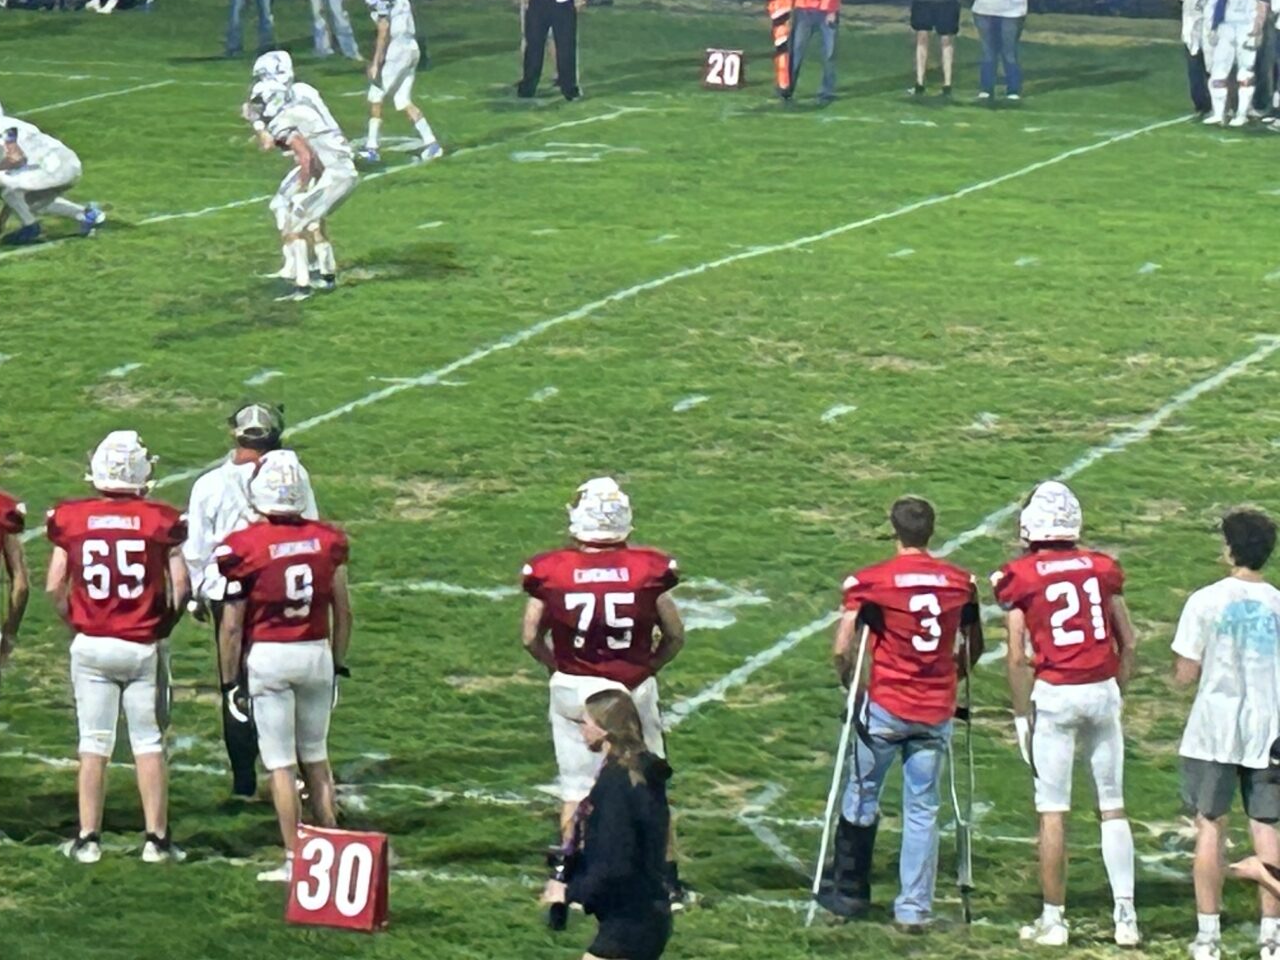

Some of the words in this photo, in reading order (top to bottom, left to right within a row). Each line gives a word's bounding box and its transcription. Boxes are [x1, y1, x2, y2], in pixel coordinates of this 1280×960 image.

[706, 53, 741, 86] 20
[82, 539, 146, 599] 65
[283, 563, 314, 619] 9
[563, 591, 634, 650] 75
[908, 592, 942, 652] 3
[1044, 577, 1106, 647] 21
[297, 837, 373, 917] 30
